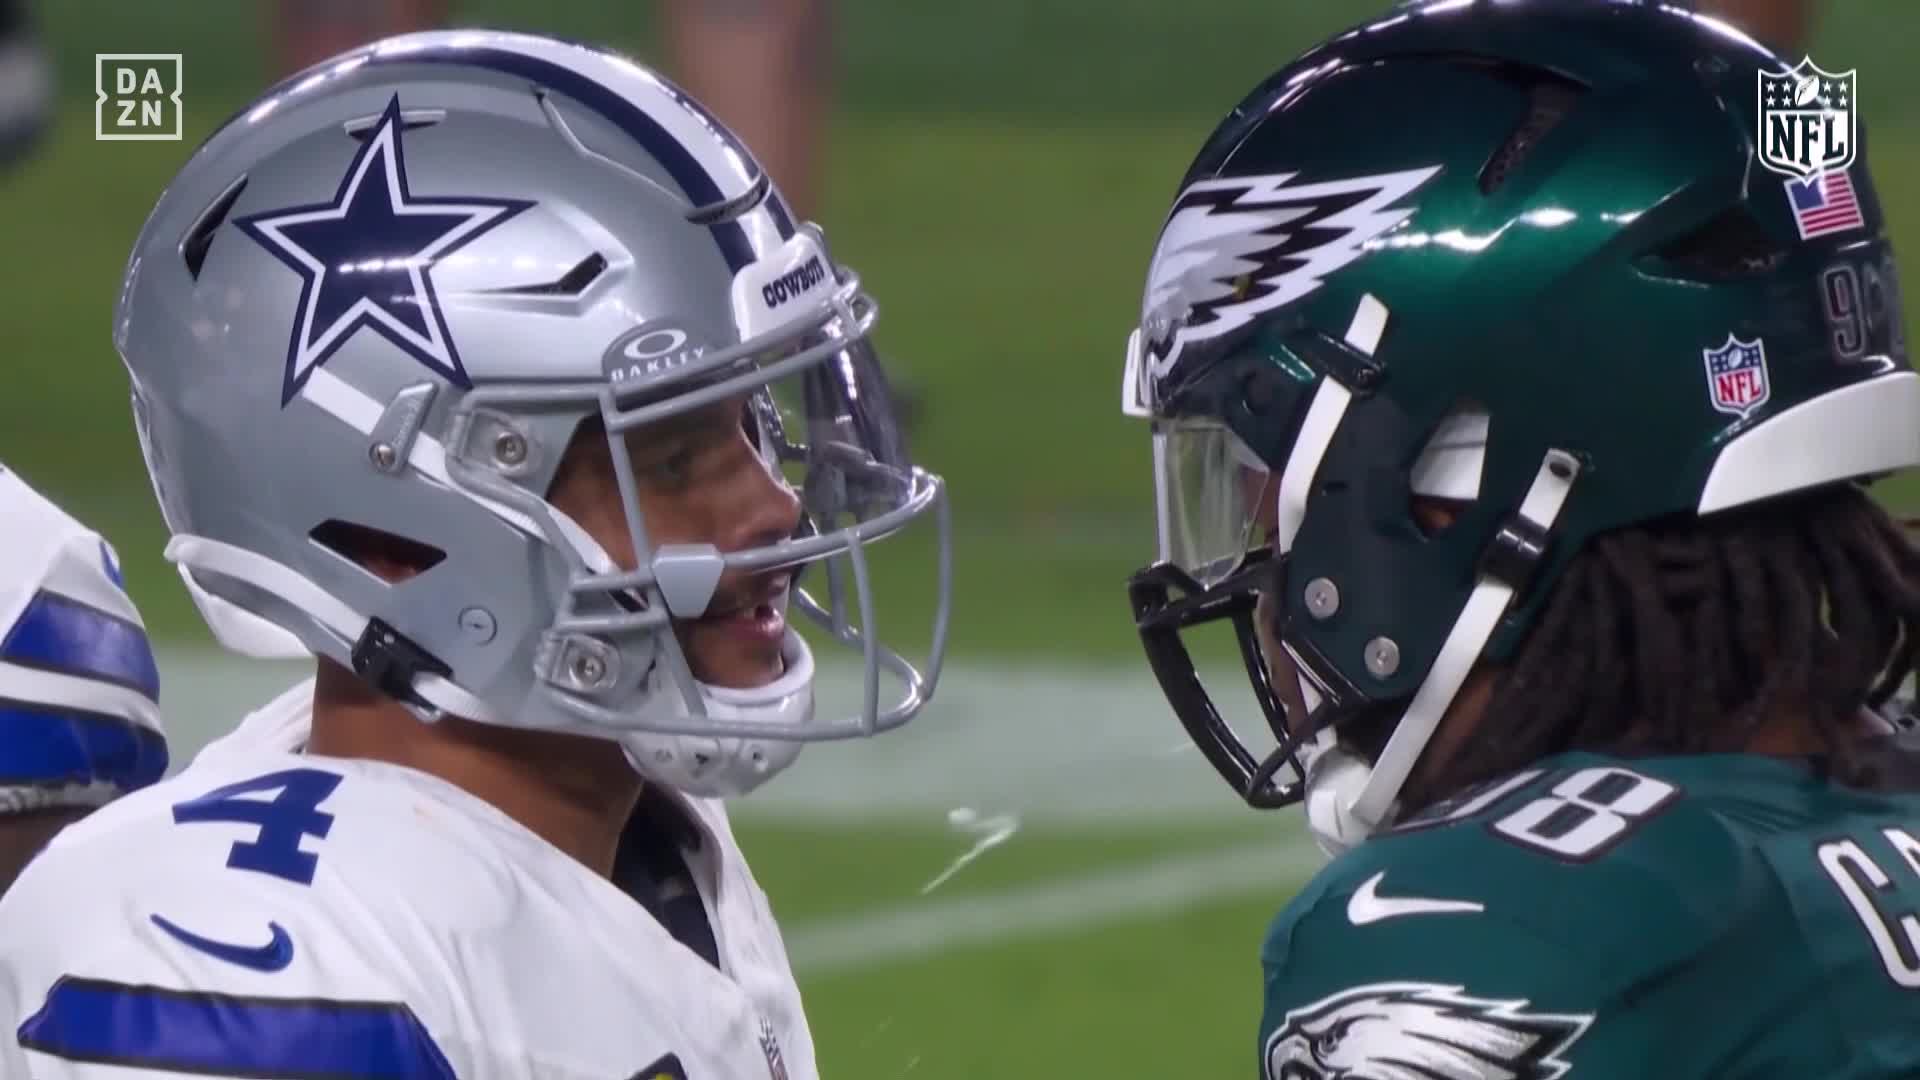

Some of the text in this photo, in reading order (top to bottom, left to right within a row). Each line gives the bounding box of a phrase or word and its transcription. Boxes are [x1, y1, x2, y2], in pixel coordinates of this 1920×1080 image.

[611, 346, 704, 381] OAKLEY
[1718, 370, 1761, 404] NFL
[172, 768, 344, 887] 4
